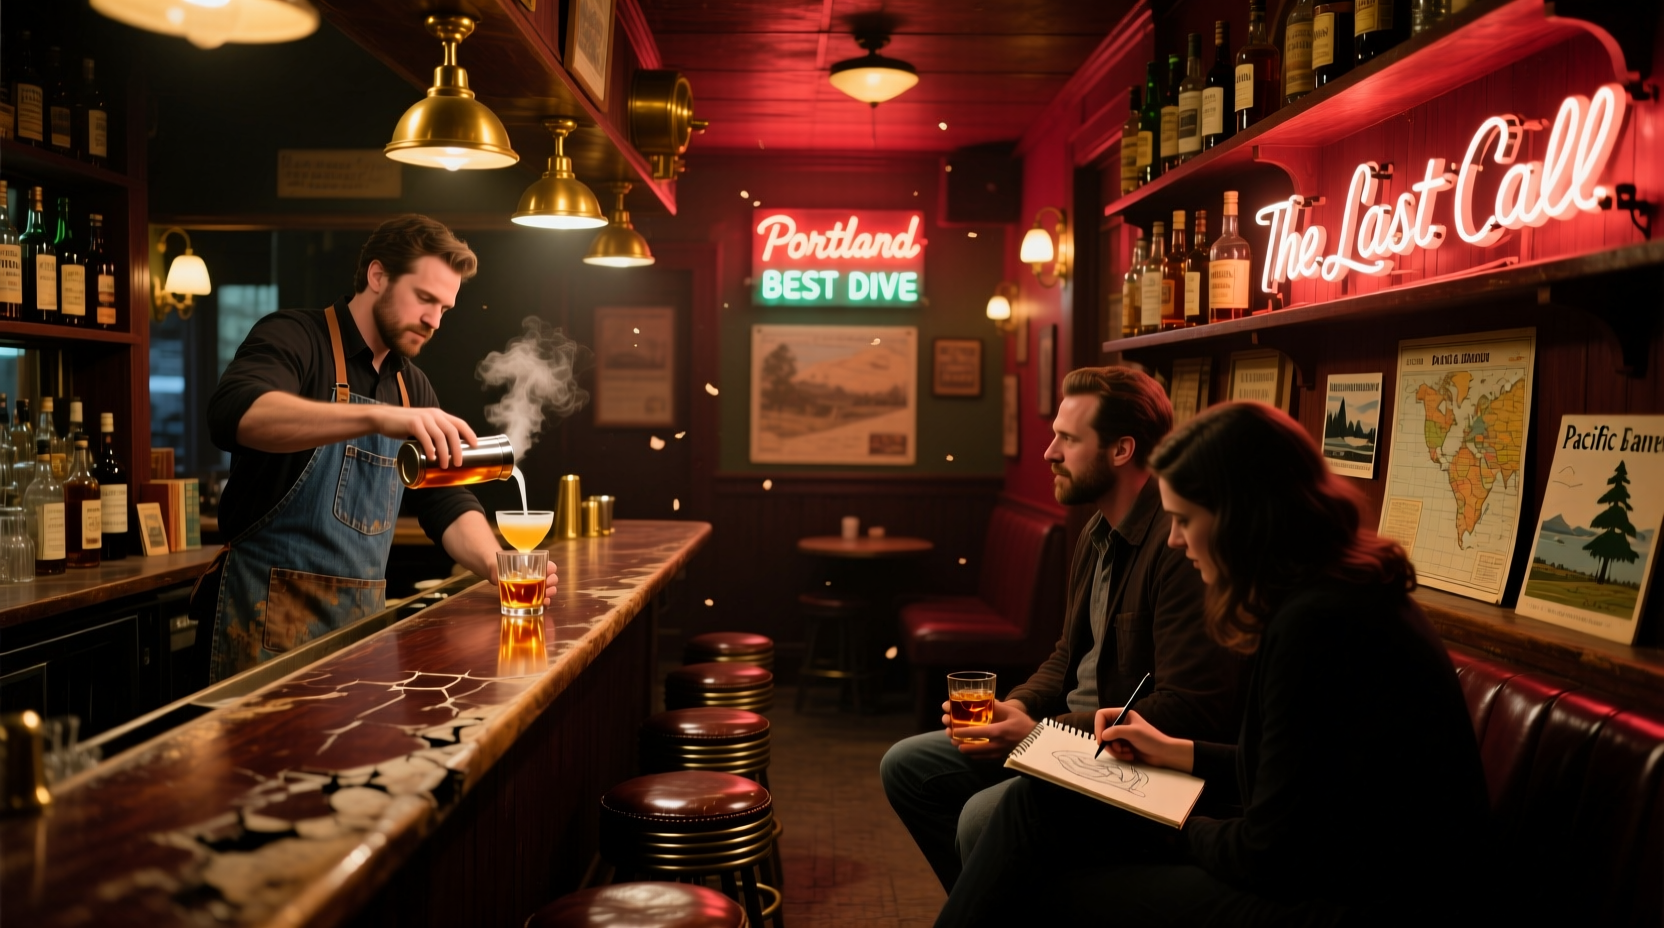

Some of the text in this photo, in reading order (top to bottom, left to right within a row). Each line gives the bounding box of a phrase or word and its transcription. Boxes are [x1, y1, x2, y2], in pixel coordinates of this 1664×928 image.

[1255, 84, 1623, 294] The Last Call
[756, 214, 921, 262] Portland
[762, 269, 918, 302] BEST DIVE
[1562, 424, 1618, 451] Pacific
